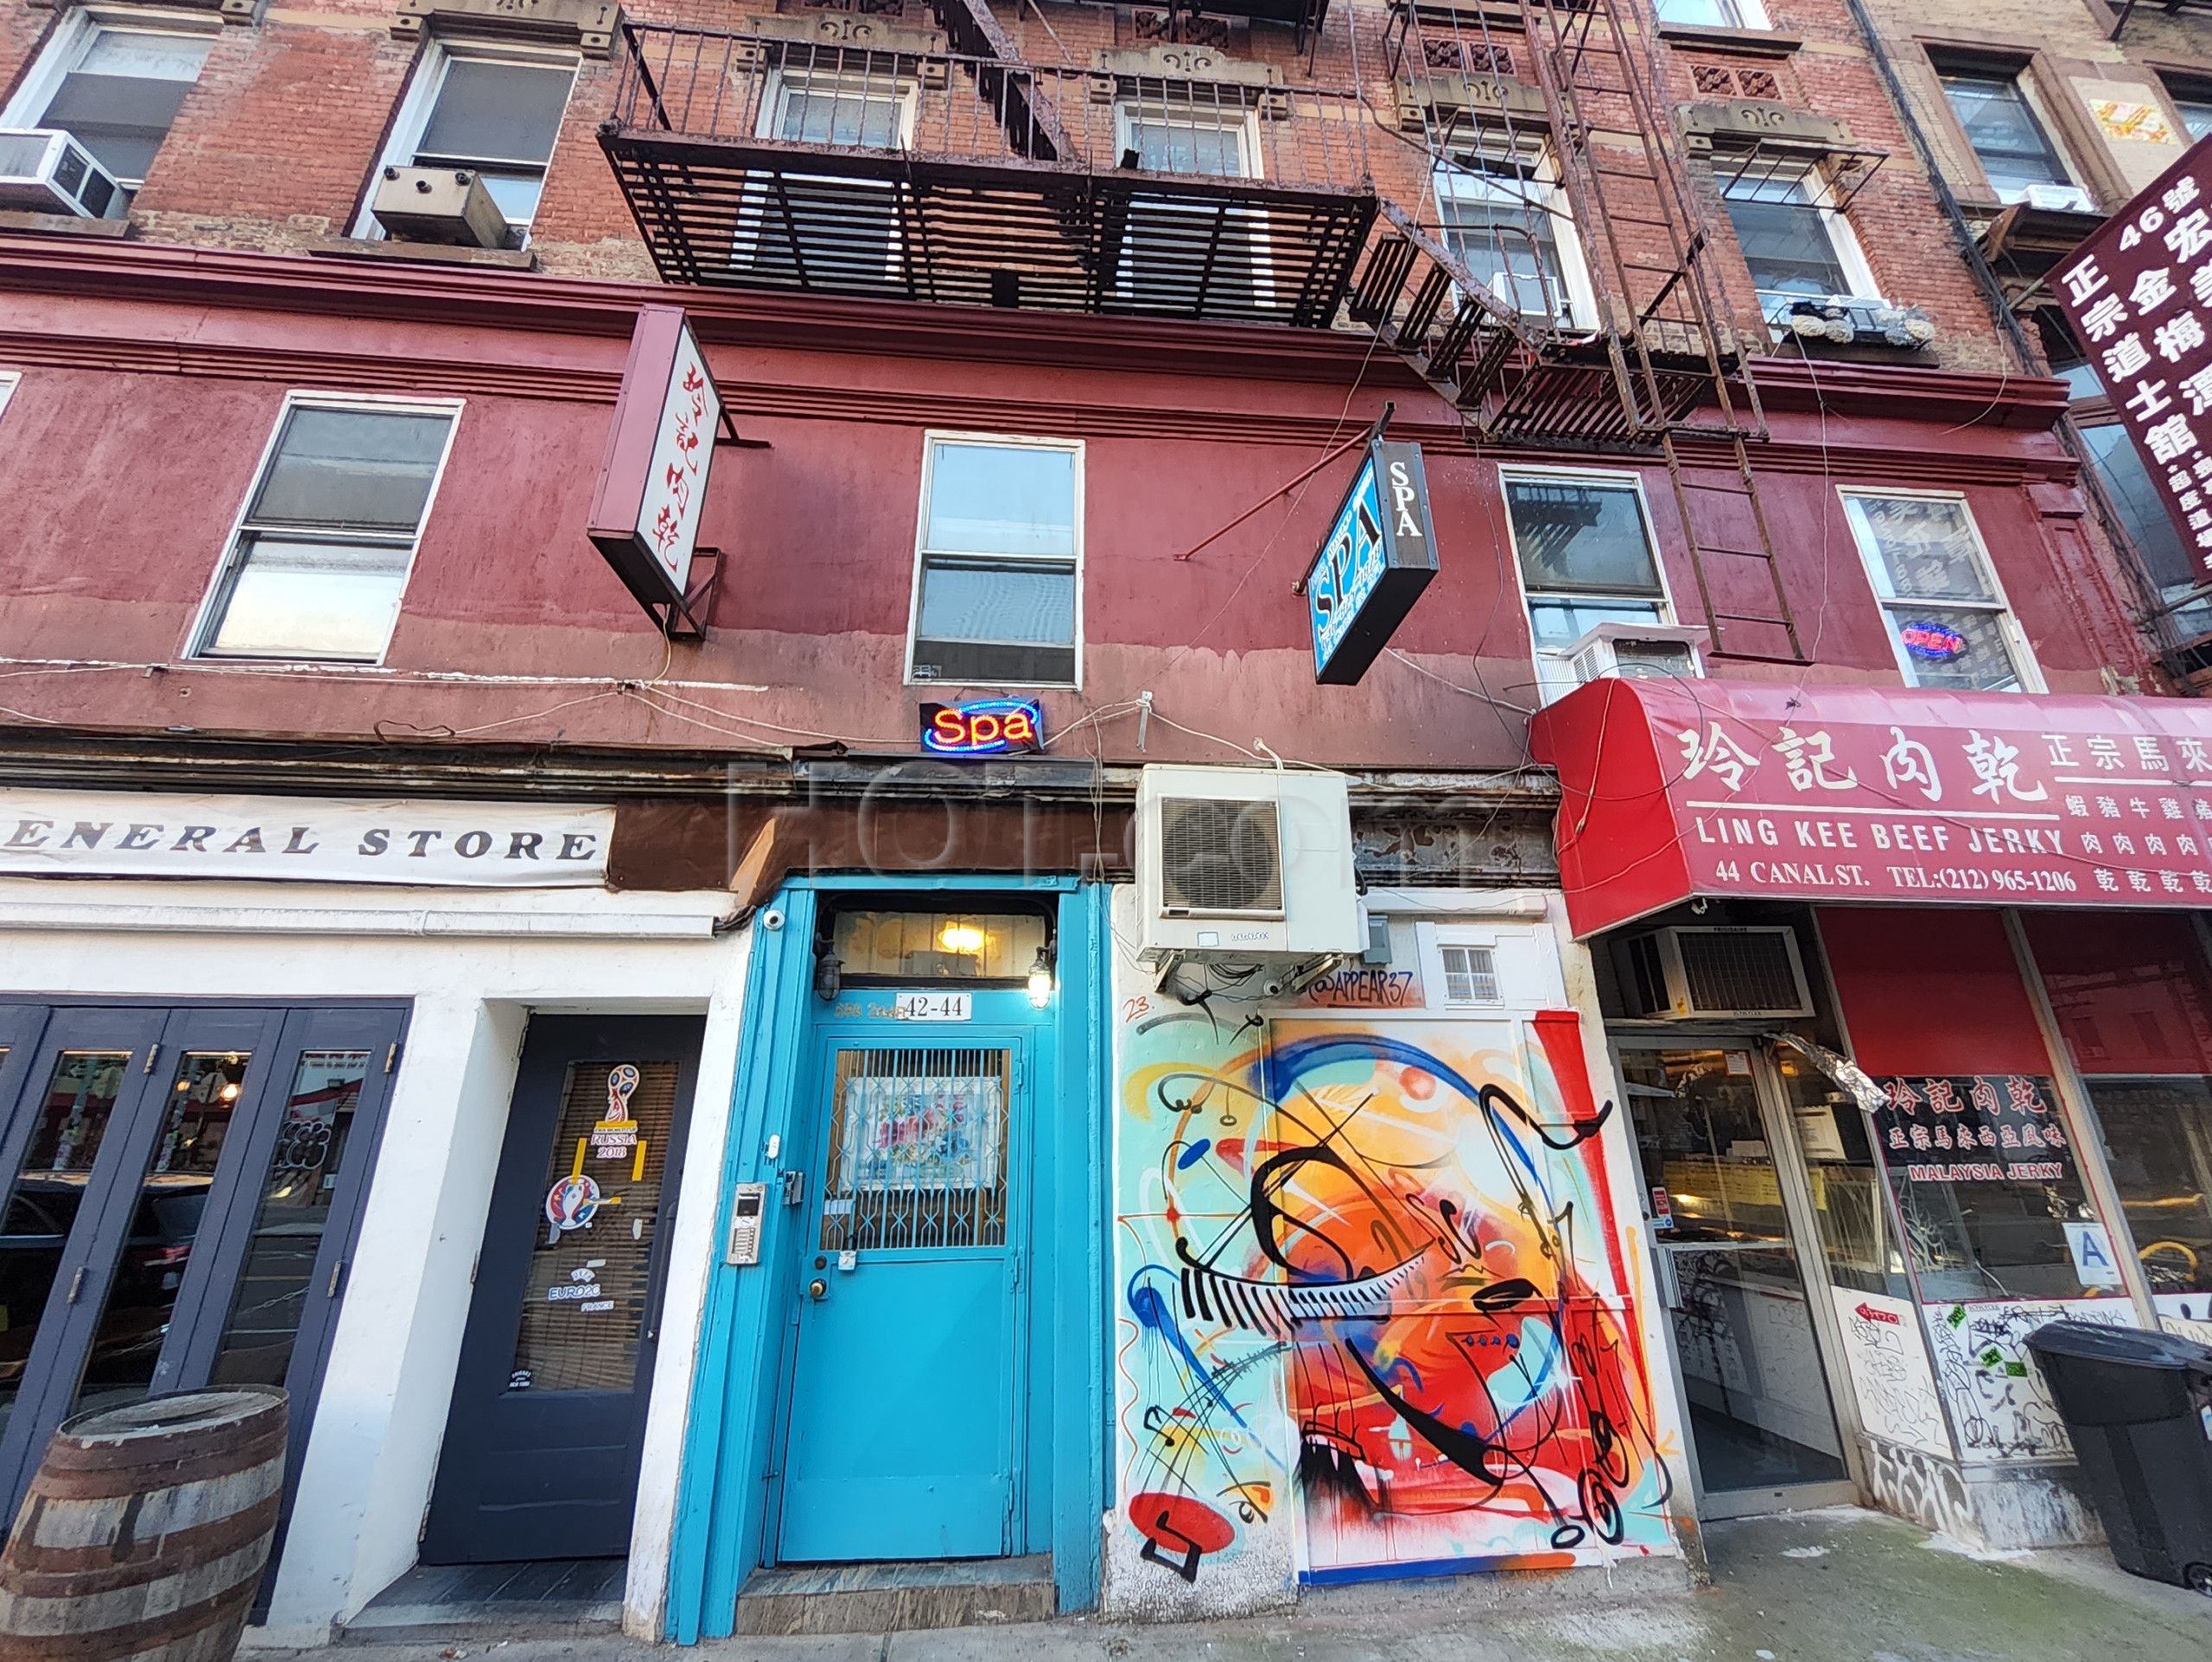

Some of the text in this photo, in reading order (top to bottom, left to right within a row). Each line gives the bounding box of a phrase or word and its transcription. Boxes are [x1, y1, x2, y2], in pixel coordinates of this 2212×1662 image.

[1389, 462, 1423, 537] SPA
[1314, 496, 1382, 638] SPA
[1901, 628, 1964, 654] OPEN
[934, 708, 1033, 746] Spa
[1677, 721, 2048, 805] 玲記肉乾
[3, 819, 597, 861] ENERAL STORE
[1695, 817, 2064, 855] LING KEE BEEF JERKY
[1715, 860, 1740, 882] 44
[1750, 861, 1834, 886] CANAL
[1991, 869, 2077, 892] 965-1206
[905, 996, 963, 1017] 42-44
[1884, 1075, 2048, 1116] 玲記肉乾
[590, 1133, 638, 1146] RUSSIA
[596, 1146, 628, 1159] 2018
[1908, 1162, 2063, 1181] MALAYSIA JERKY
[2082, 1231, 2109, 1266] A
